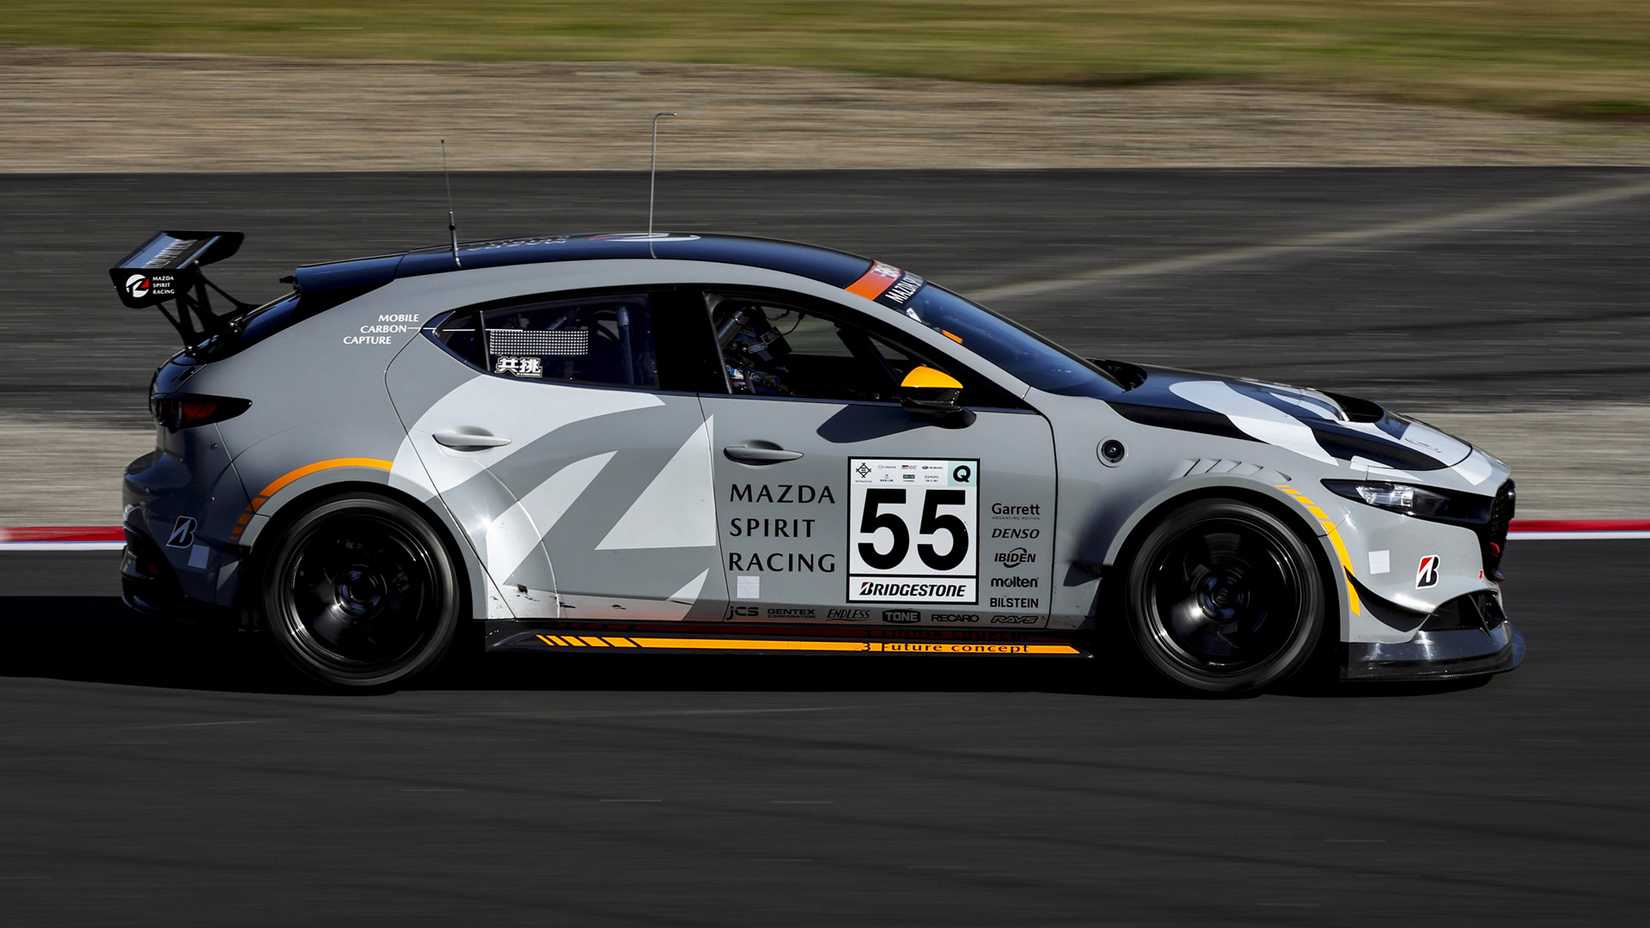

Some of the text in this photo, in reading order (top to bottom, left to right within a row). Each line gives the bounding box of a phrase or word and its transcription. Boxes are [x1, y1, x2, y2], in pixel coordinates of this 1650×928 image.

[378, 313, 420, 322] MOBILE
[360, 324, 407, 333] CARBON
[343, 336, 392, 345] CAPTURE
[953, 465, 971, 483] Q
[730, 484, 835, 504] MAZDA
[991, 503, 1040, 515] Garrett
[730, 517, 816, 538] SPIRIT
[858, 488, 969, 571] 55
[991, 528, 1040, 539] DENSO
[729, 552, 836, 573] RACING
[994, 551, 1037, 565] IBIDEN
[991, 576, 1038, 588] molten
[859, 581, 967, 597] BRIDGESTONE
[990, 597, 1039, 608] BILSTEIN
[827, 607, 871, 619] ENDLESS
[884, 611, 920, 622] TONE
[931, 614, 980, 623] RECARO
[881, 641, 943, 652] Future
[951, 641, 1029, 654] concept
